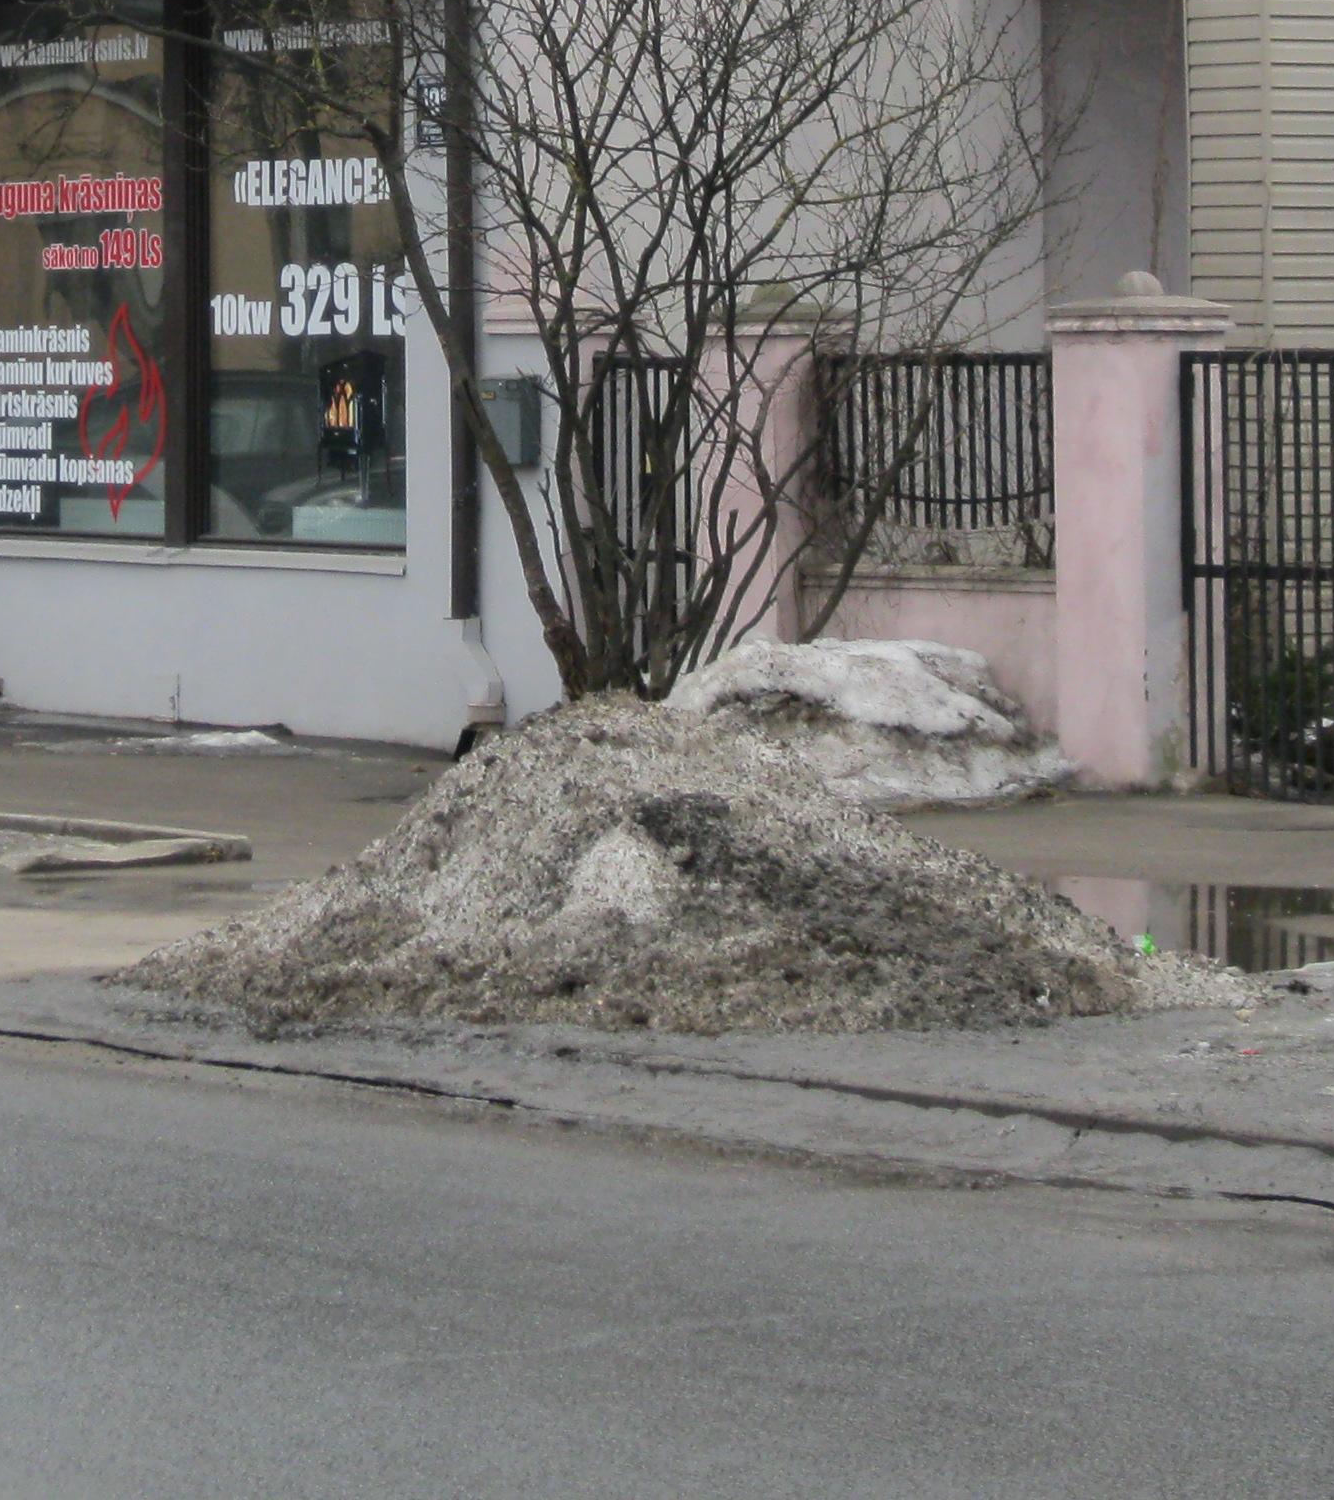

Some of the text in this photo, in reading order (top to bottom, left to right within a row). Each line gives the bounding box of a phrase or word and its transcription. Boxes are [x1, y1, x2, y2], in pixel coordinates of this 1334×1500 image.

[58, 172, 162, 223] krāsniņas
[42, 228, 162, 269] sākot no 149 Ls
[211, 293, 272, 335] 10kw
[280, 262, 360, 336] 329
[46, 357, 113, 385] kurtuves
[59, 453, 134, 486] kopšanas
